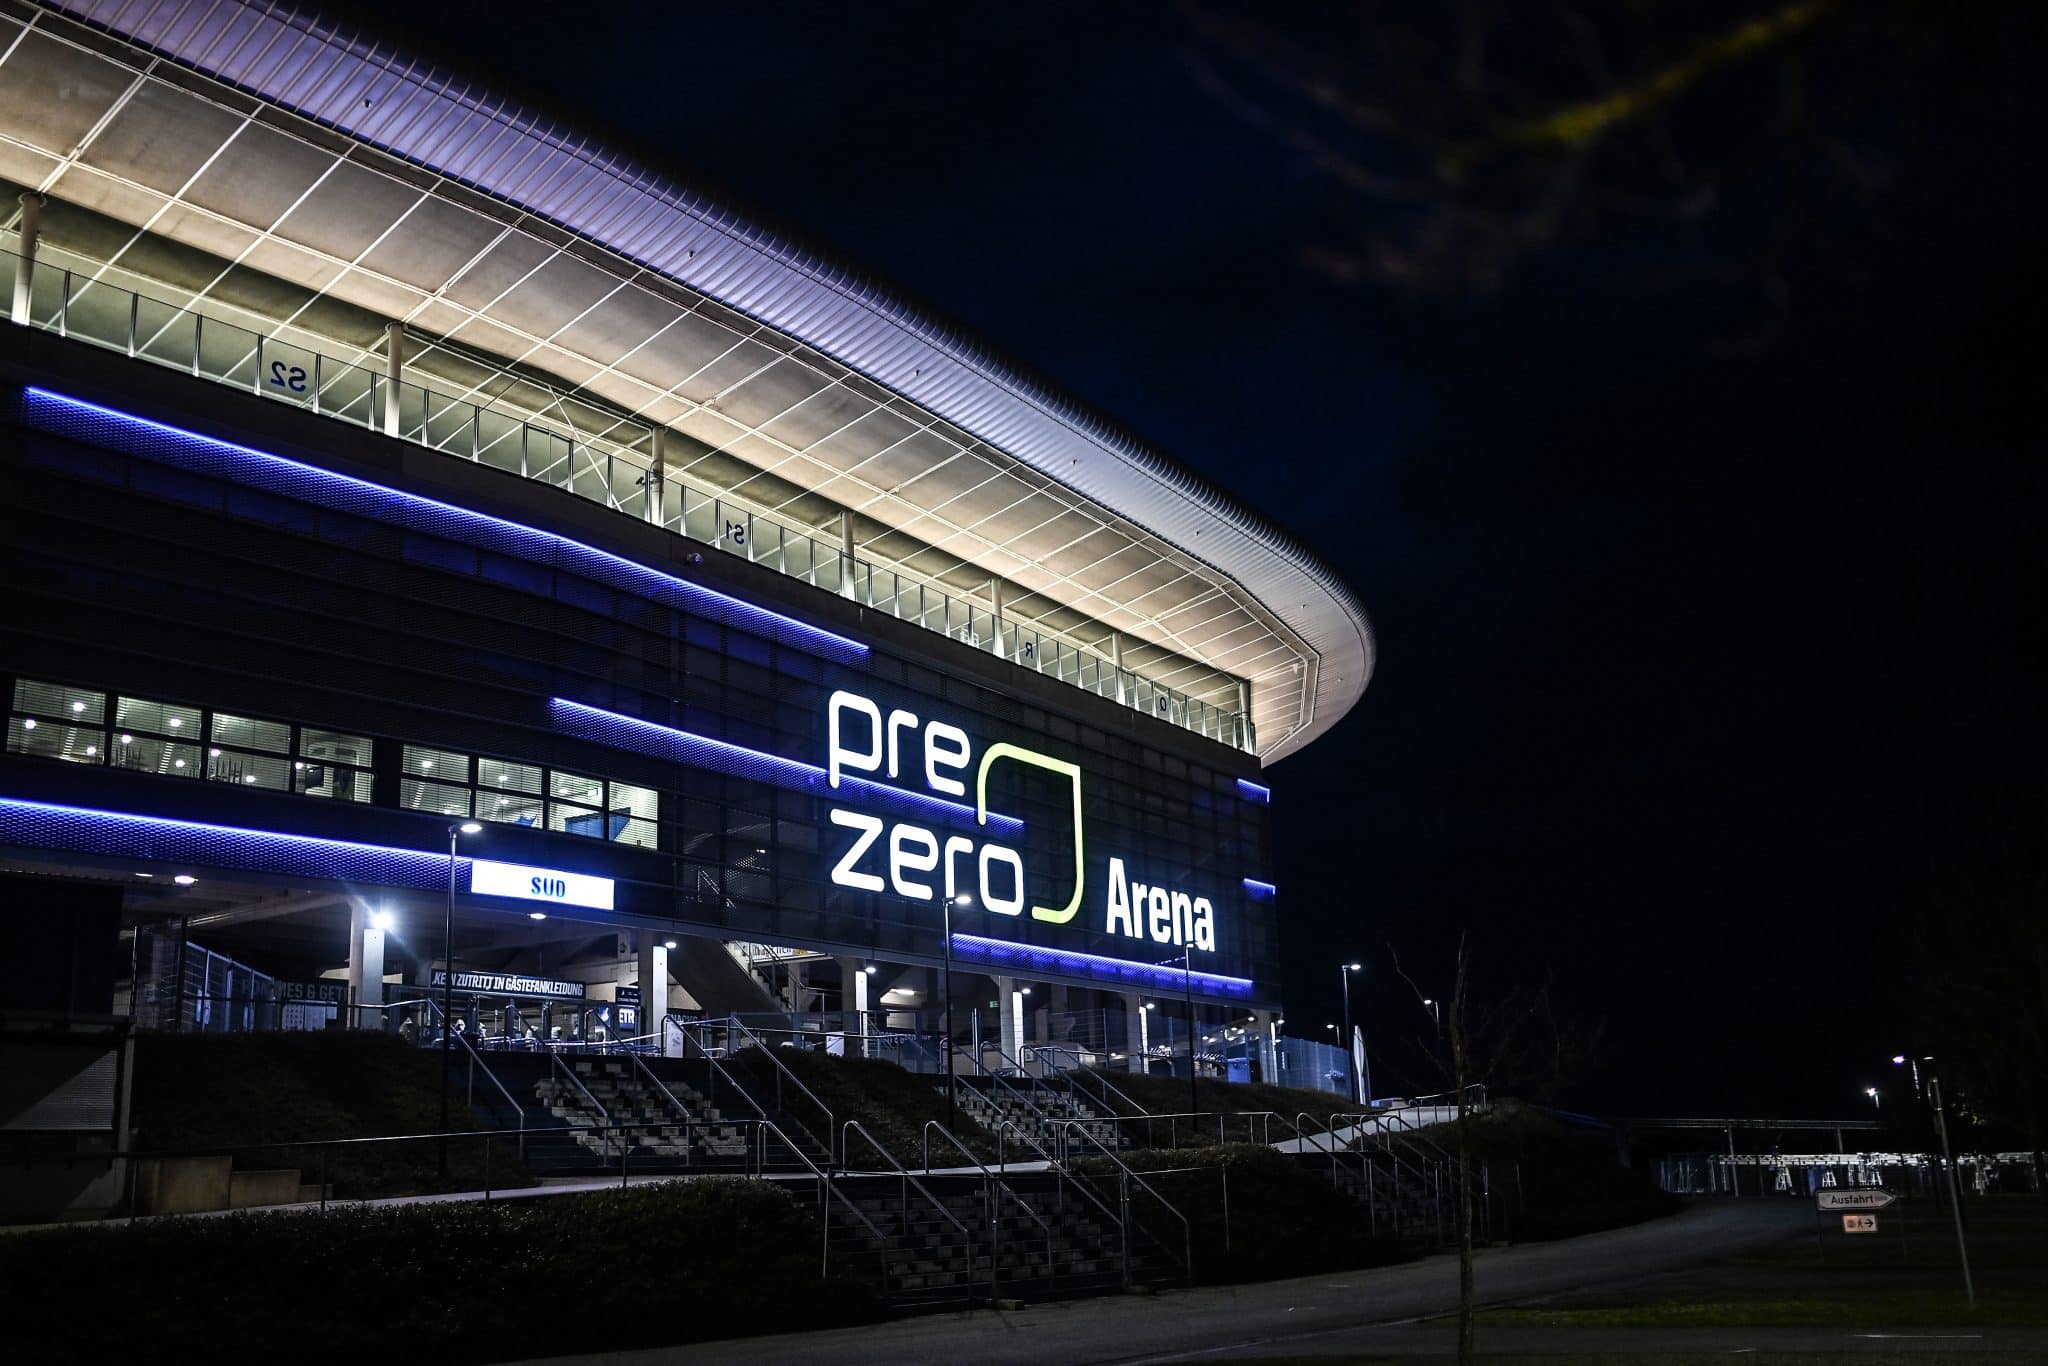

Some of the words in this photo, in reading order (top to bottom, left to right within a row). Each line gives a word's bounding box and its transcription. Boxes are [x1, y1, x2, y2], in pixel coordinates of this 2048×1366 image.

[828, 690, 971, 797] pre
[830, 808, 1025, 917] zero
[1106, 857, 1216, 952] Arena
[432, 971, 456, 986] KEN
[1831, 1194, 1874, 1205] Ausfahrt
